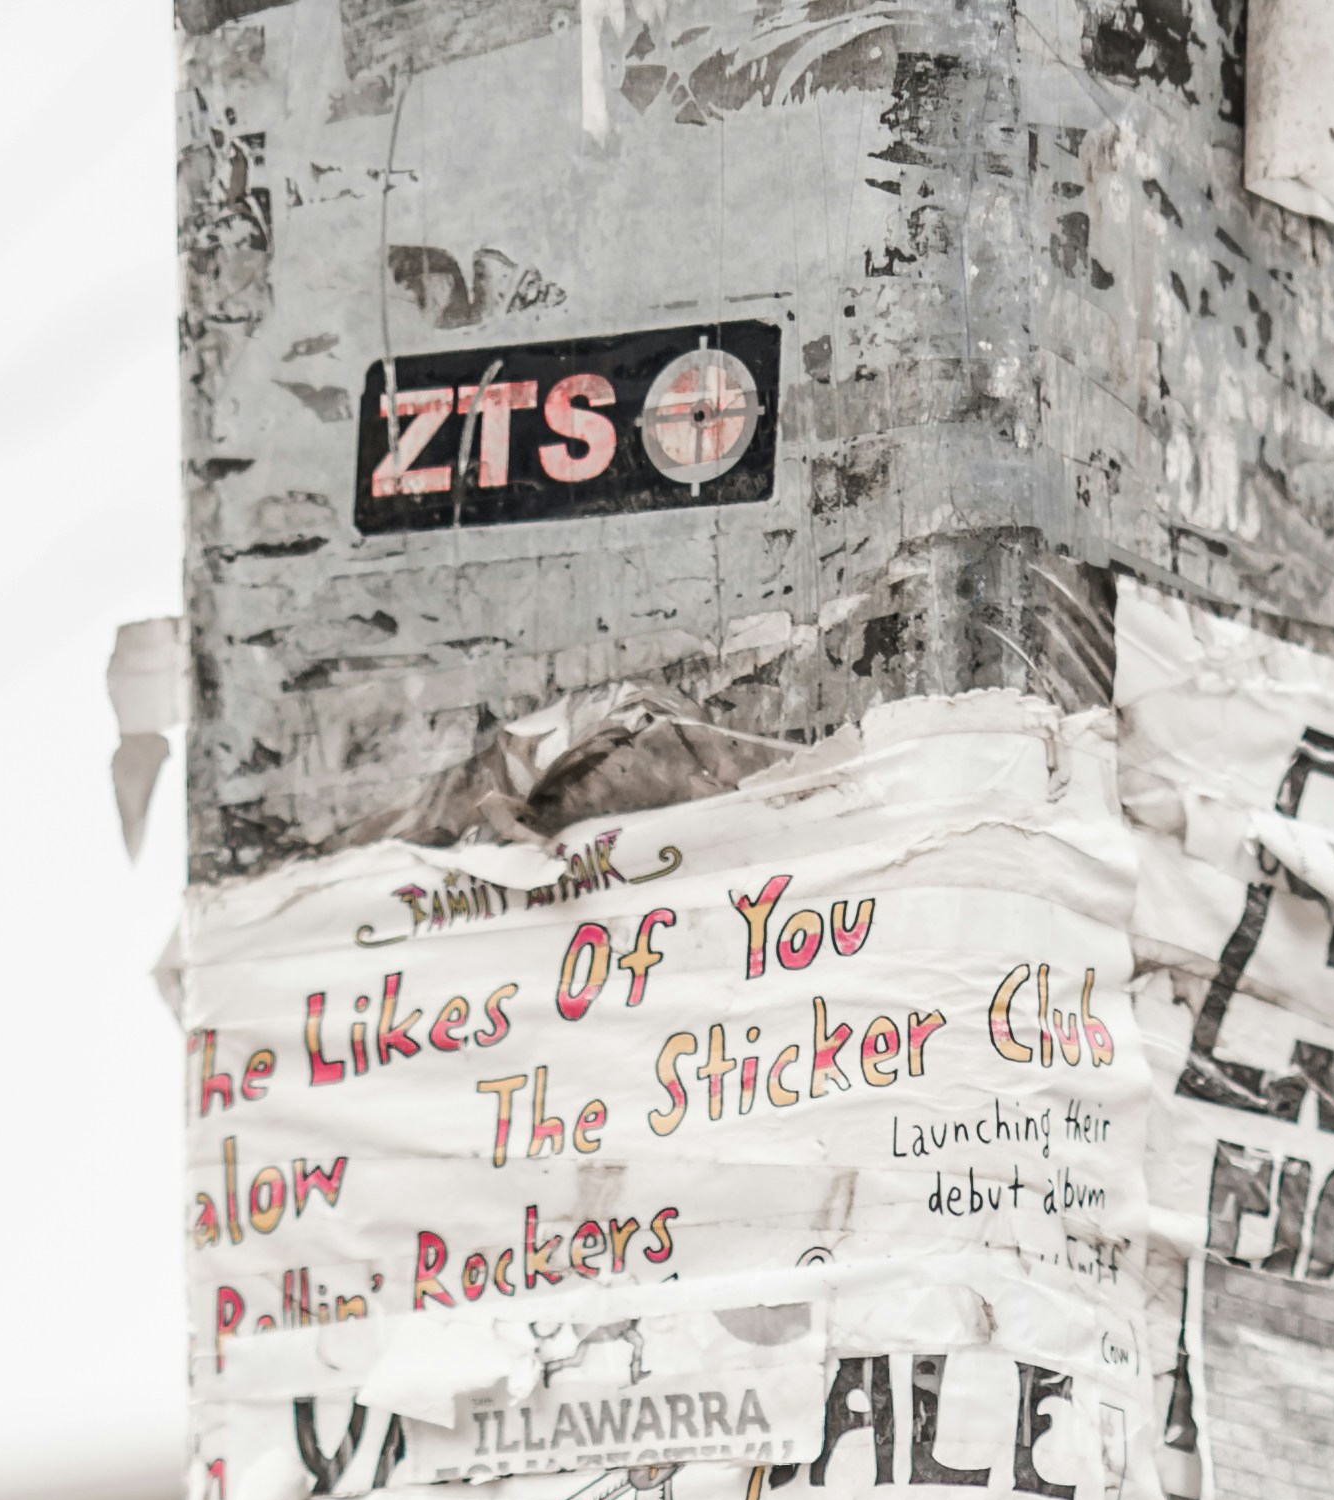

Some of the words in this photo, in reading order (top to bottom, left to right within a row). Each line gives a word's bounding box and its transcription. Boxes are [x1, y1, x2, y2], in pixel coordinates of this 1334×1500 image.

[369, 372, 619, 500] ZTS
[305, 971, 520, 1087] Likes
[557, 908, 677, 1022] Of
[729, 874, 876, 980] You
[477, 1065, 607, 1168] The
[647, 996, 948, 1137] Sticker
[988, 963, 1115, 1069] Club
[893, 1097, 1051, 1158] Launching
[1065, 1098, 1111, 1144] their
[928, 1164, 1025, 1217] debut
[1043, 1166, 1106, 1215] album
[413, 1204, 680, 1311] Rockers
[472, 1388, 772, 1457] ILLAWARRA
